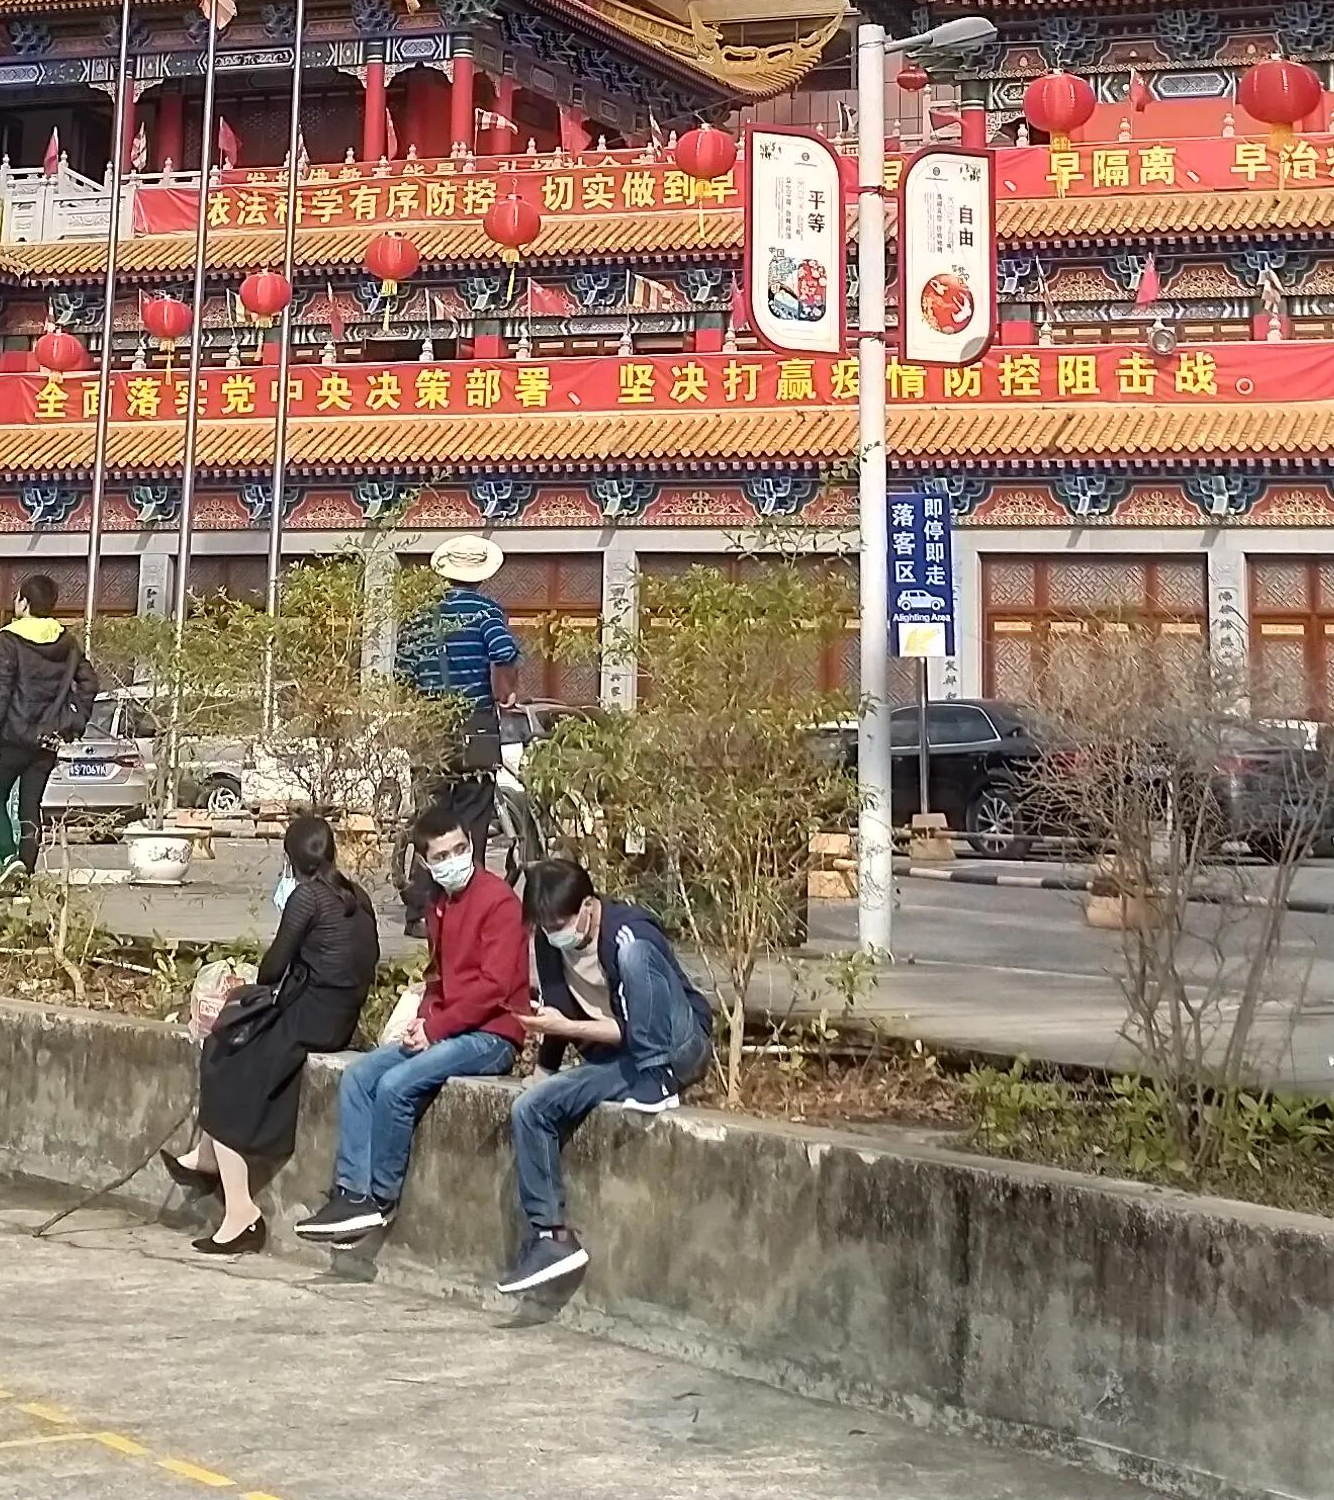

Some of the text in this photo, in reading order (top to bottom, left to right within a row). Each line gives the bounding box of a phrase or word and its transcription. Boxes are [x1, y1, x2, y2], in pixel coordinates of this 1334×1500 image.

[807, 190, 826, 234] 平等
[959, 204, 974, 248] 自由
[891, 503, 917, 584] 落客区
[923, 497, 946, 586] 即停即走
[893, 612, 951, 624] Alighting Area
